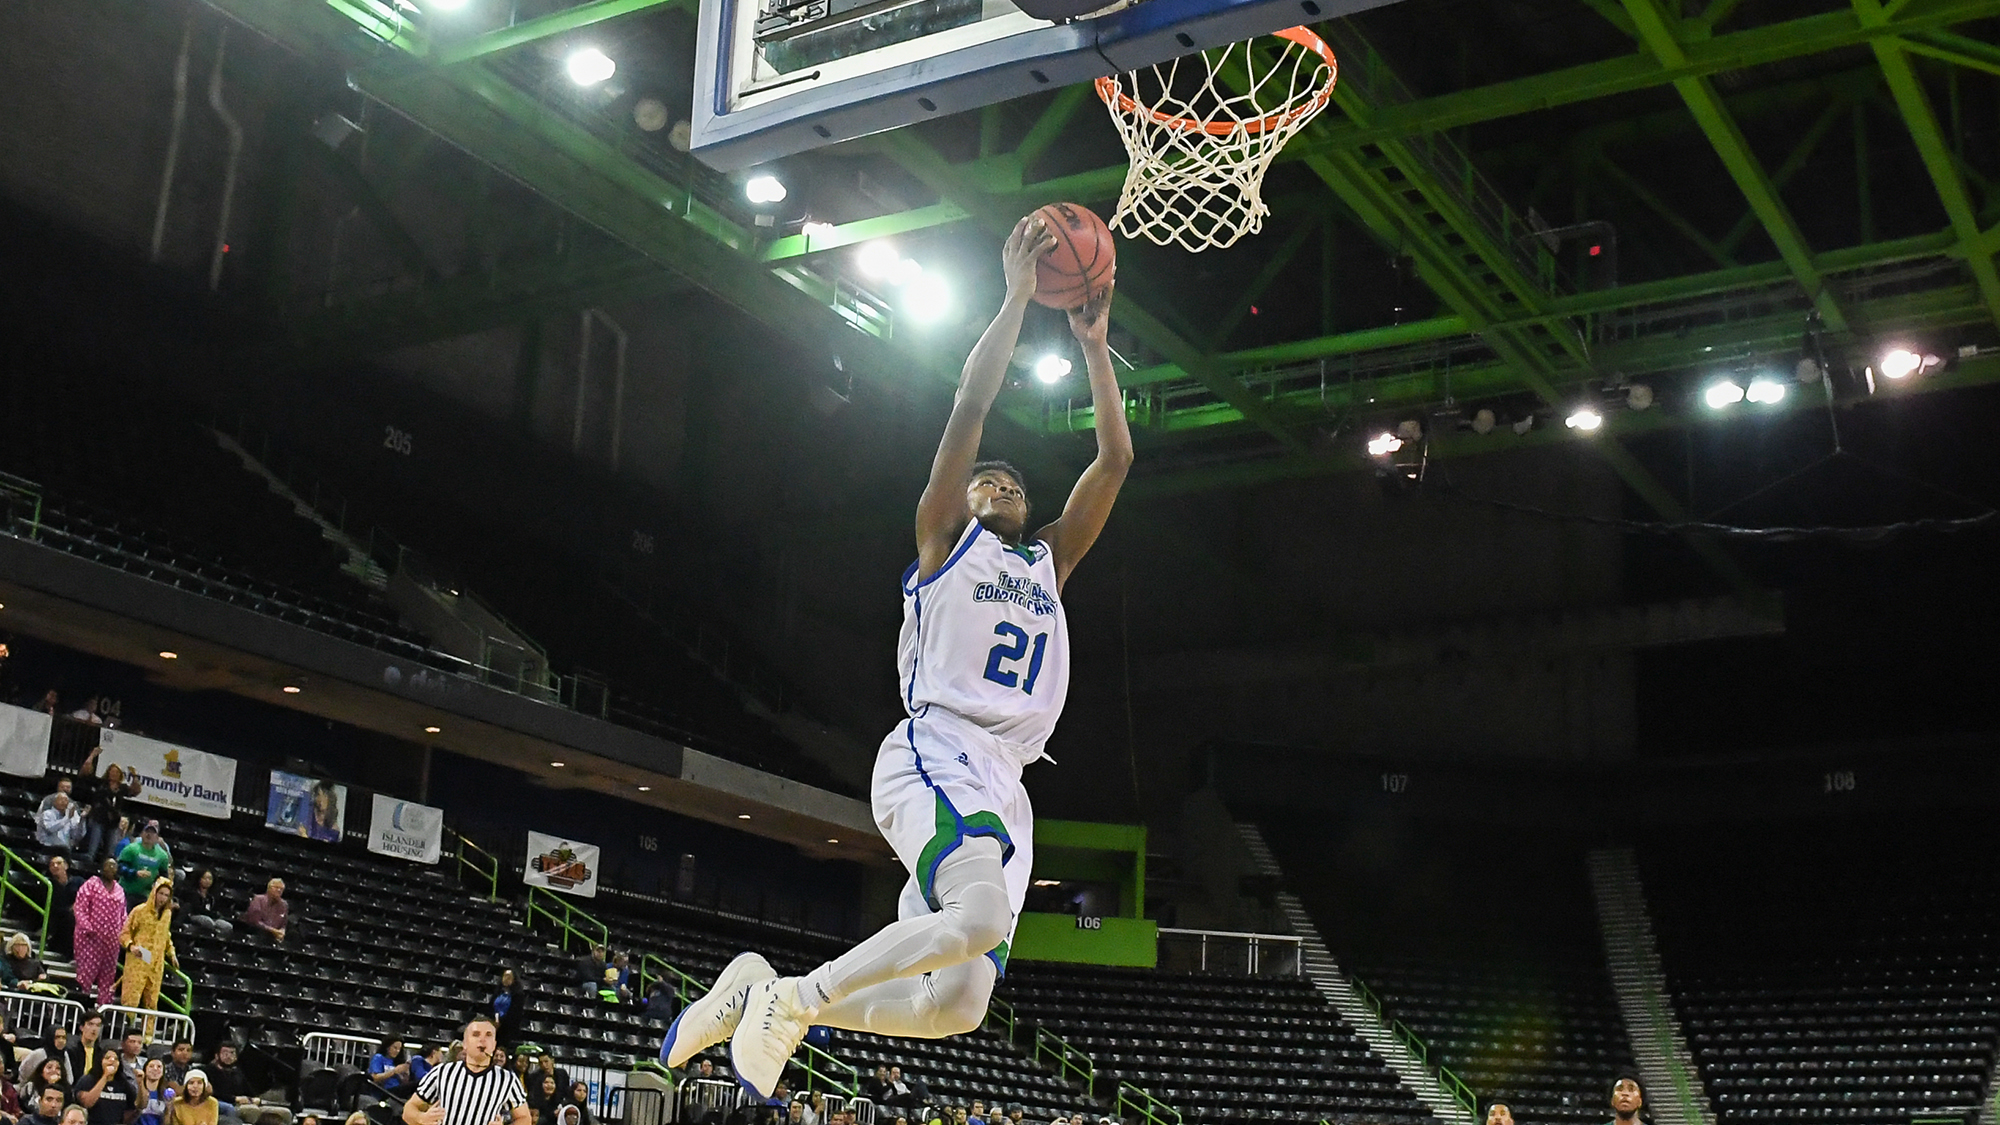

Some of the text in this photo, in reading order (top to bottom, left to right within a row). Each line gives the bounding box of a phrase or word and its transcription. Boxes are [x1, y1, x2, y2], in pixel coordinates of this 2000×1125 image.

[384, 425, 412, 456] 205
[983, 620, 1048, 696] 21
[95, 696, 121, 717] 04
[1381, 773, 1408, 793] 107
[193, 784, 228, 804] Bank
[382, 832, 426, 850] ISLANDER
[382, 843, 424, 858] HOUSING
[639, 835, 658, 852] 105
[1077, 916, 1101, 929] 106
